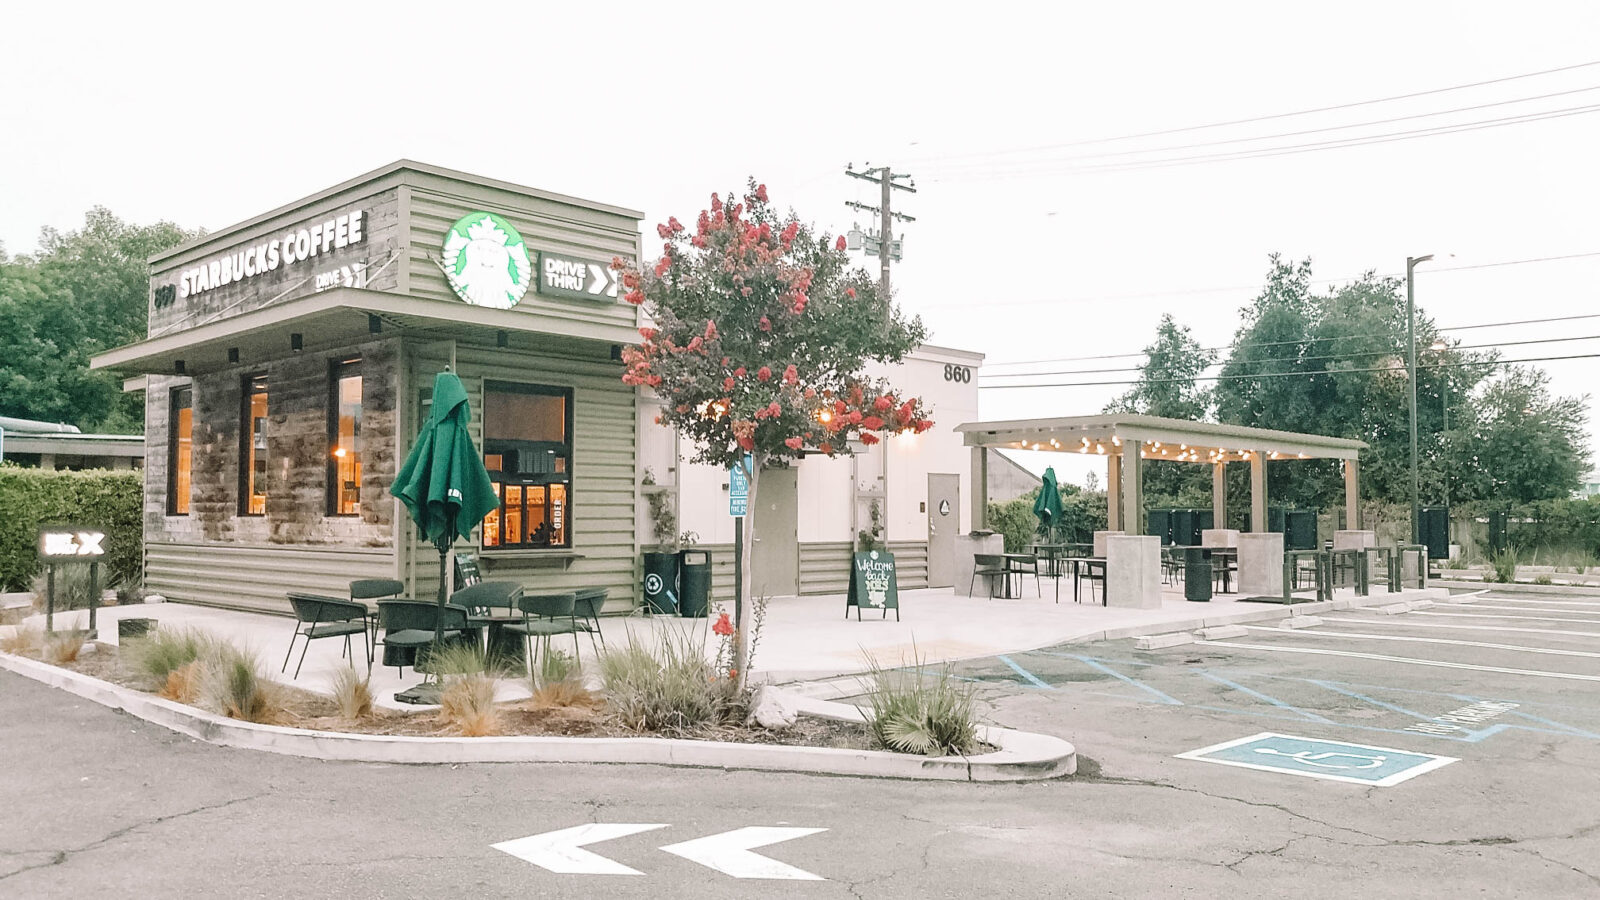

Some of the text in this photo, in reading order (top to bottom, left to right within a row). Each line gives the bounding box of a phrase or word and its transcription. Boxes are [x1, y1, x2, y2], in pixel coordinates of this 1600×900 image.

[180, 210, 363, 298] STARBUCKS COFFEE
[545, 258, 586, 278] DRIVE
[315, 269, 341, 289] DRIVE
[545, 272, 585, 292] THRU
[944, 363, 971, 384] 860
[554, 499, 562, 529] ORDER
[856, 559, 894, 572] Welcome
